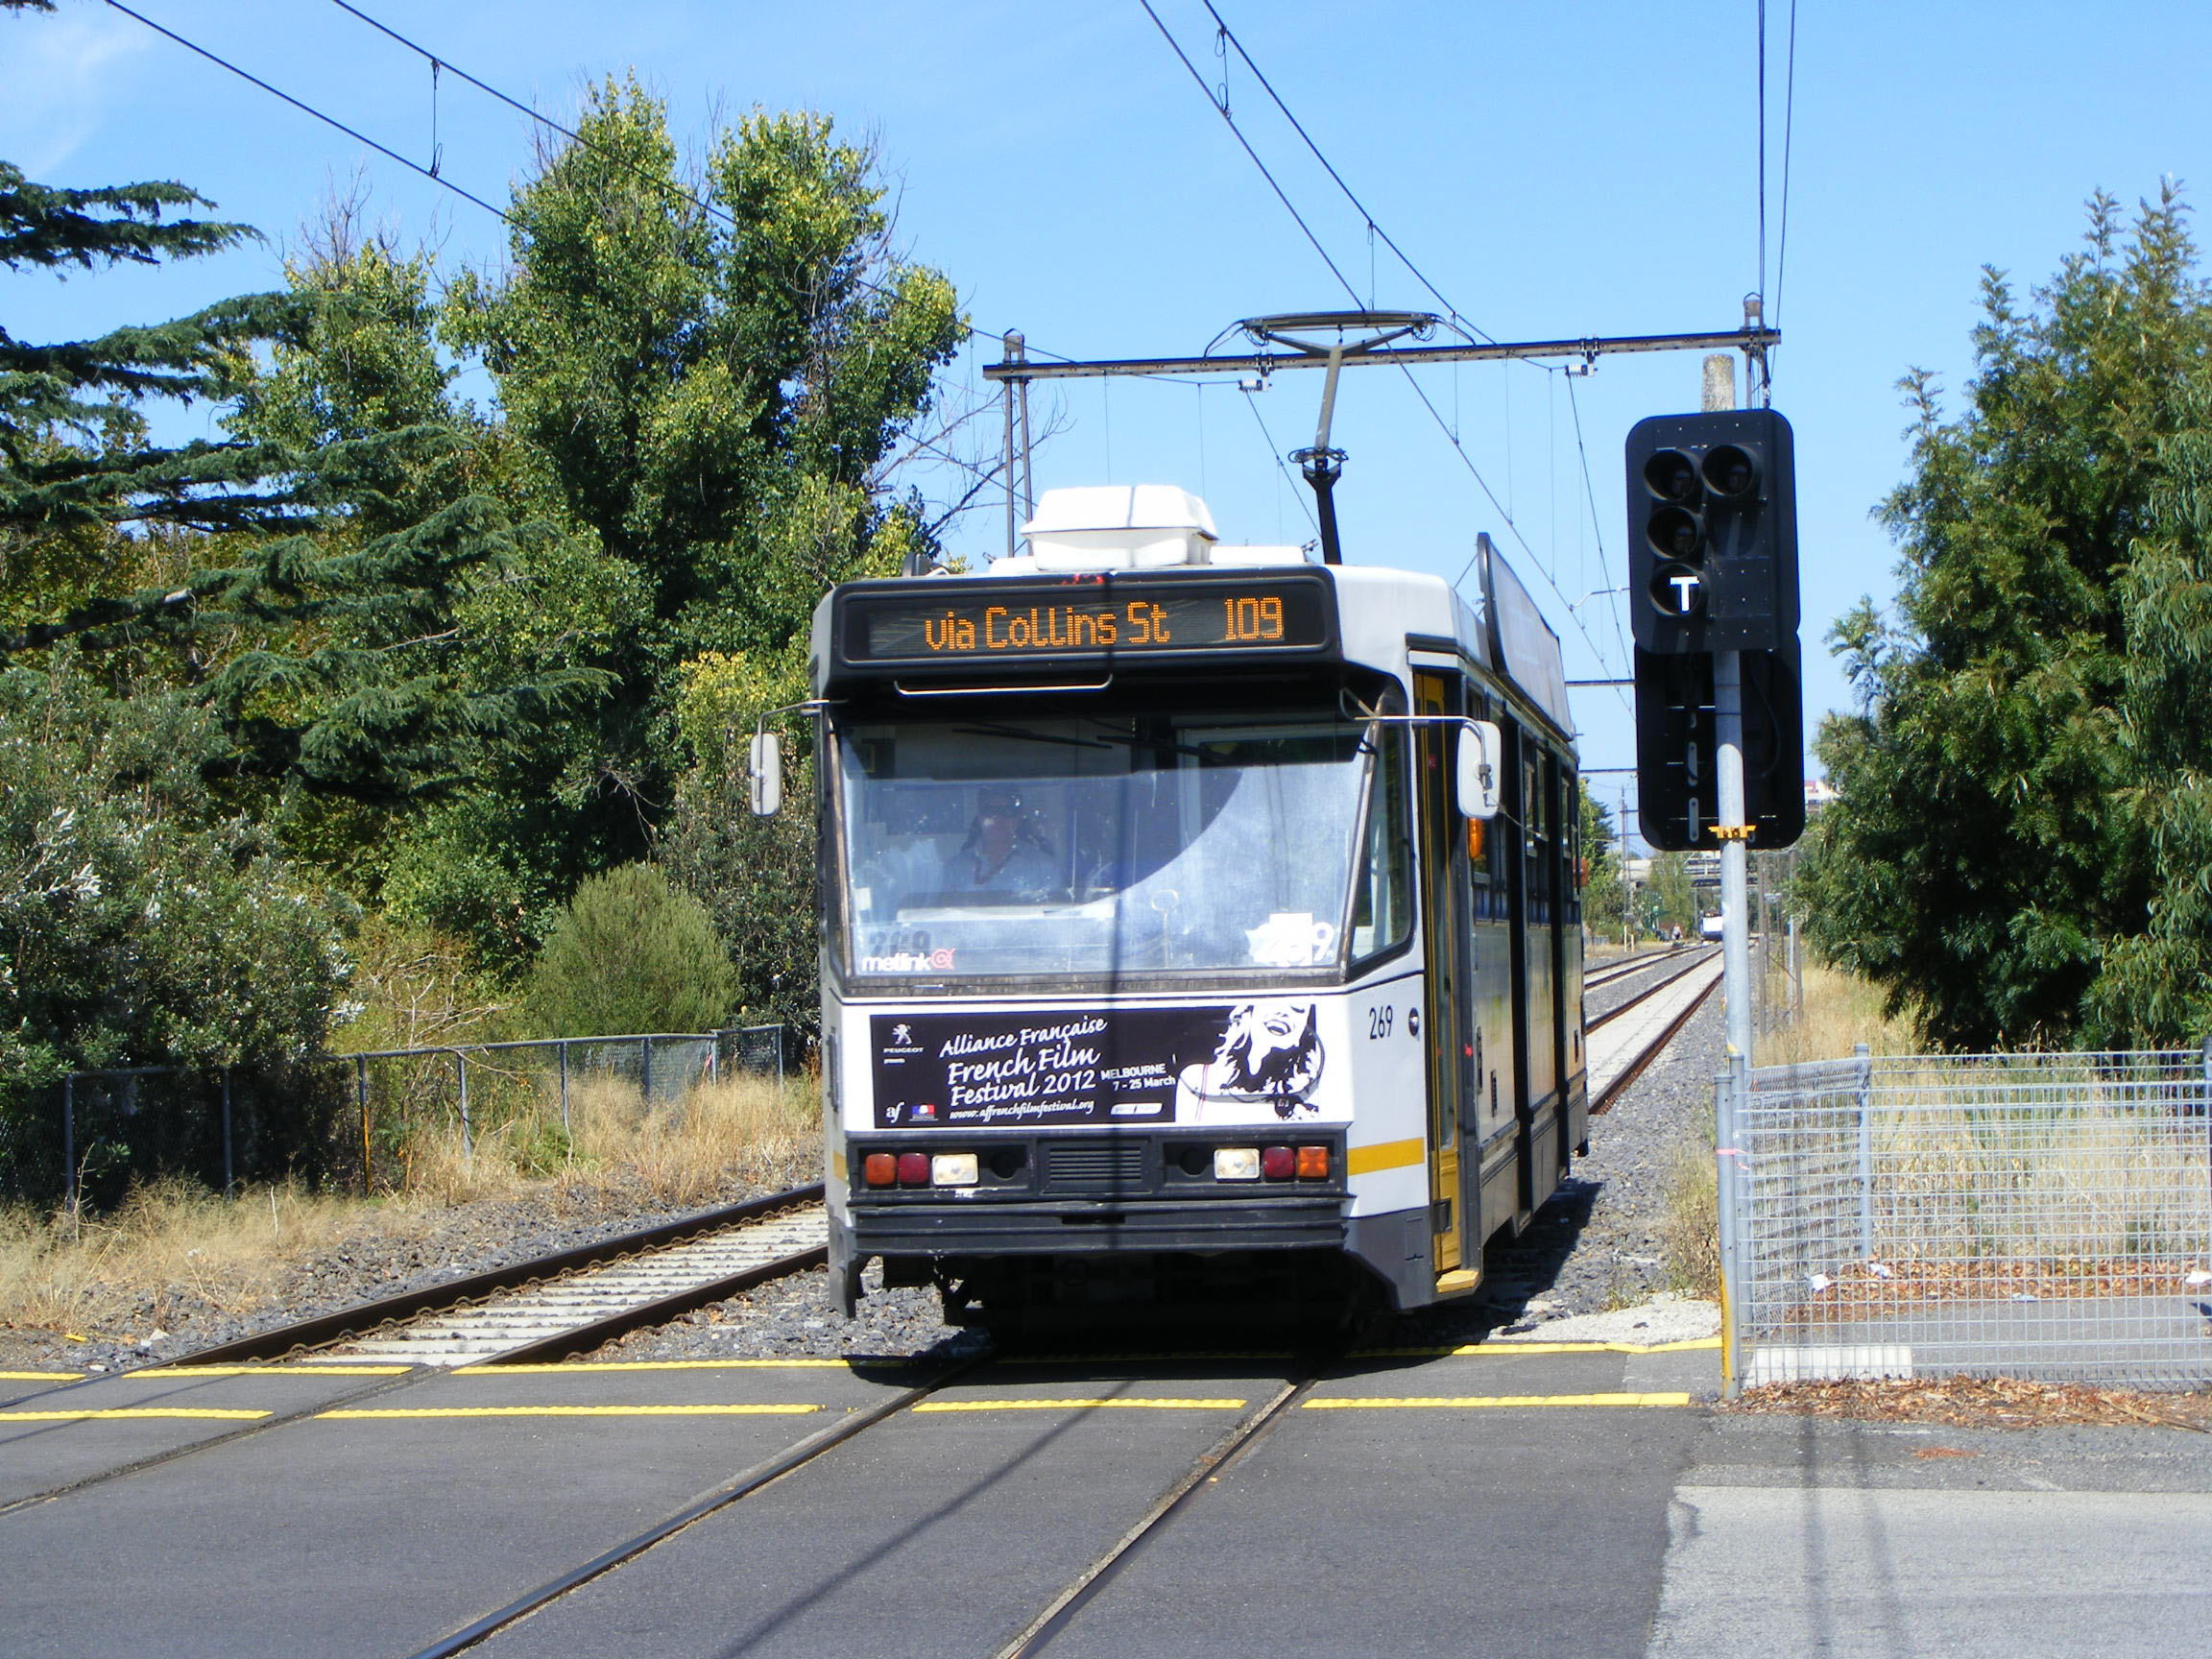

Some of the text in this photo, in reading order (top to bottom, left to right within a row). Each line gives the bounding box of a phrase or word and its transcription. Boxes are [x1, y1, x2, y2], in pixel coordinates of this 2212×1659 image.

[1671, 576, 1699, 612] T
[925, 602, 1170, 650] via Collins St
[1224, 597, 1283, 640] 109
[861, 952, 931, 972] metlink
[939, 1015, 1108, 1058] Alliance Française
[1369, 1004, 1393, 1040] 269
[948, 1041, 1101, 1085] French Film
[1100, 1063, 1166, 1080] MELBOURNE
[950, 1070, 1096, 1107] Festival 2012
[1113, 1081, 1119, 1091] 7
[1129, 1078, 1142, 1090] 25
[1143, 1075, 1176, 1088] March
[886, 1101, 905, 1123] af
[950, 1098, 1094, 1122] www.affrenchfilmfestival.org
